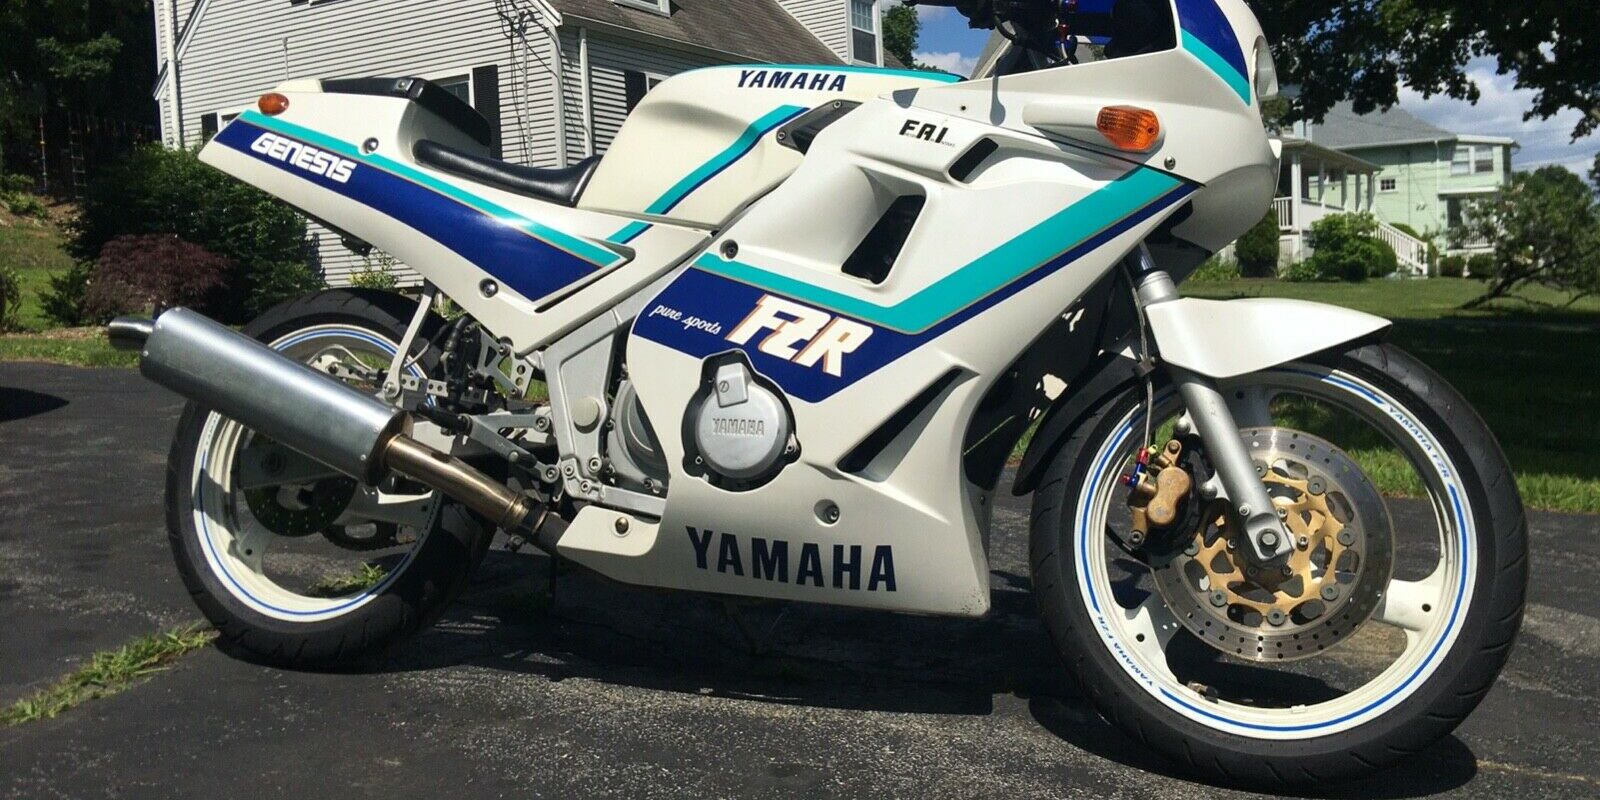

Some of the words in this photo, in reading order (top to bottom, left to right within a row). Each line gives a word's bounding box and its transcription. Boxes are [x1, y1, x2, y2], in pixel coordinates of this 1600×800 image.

[737, 70, 847, 92] YAMAHA
[250, 132, 358, 184] GENESIS
[648, 304, 682, 320] pure
[681, 316, 722, 335] sports
[724, 293, 874, 377] FZR
[712, 417, 765, 437] YAMAHA
[1389, 406, 1432, 451] YAMAHA
[685, 525, 897, 592] YAMAHA
[1113, 642, 1153, 686] YAMAHA
